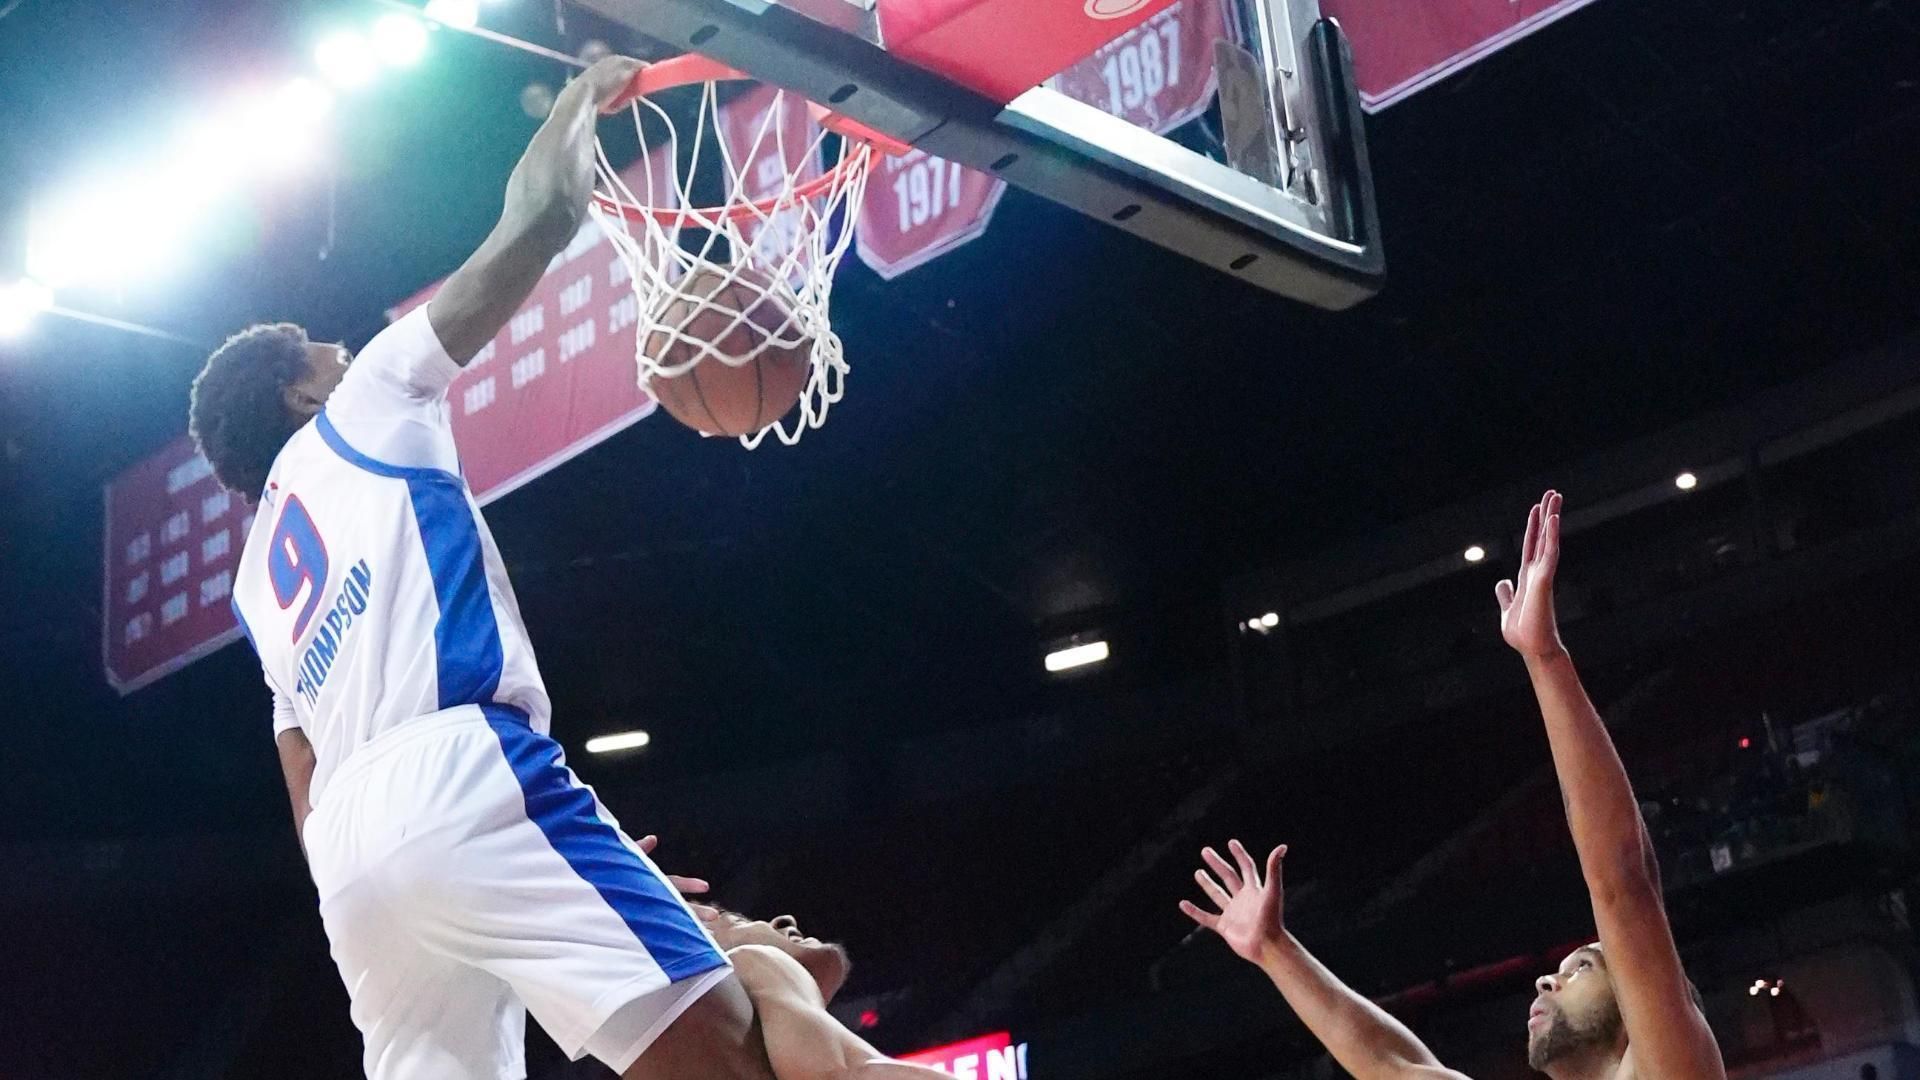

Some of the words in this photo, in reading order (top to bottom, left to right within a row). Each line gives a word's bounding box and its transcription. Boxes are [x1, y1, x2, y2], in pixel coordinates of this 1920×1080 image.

[1103, 19, 1181, 117] 1987
[893, 154, 961, 233] 1977
[268, 492, 329, 646] 9
[296, 558, 372, 714] THOMPSON
